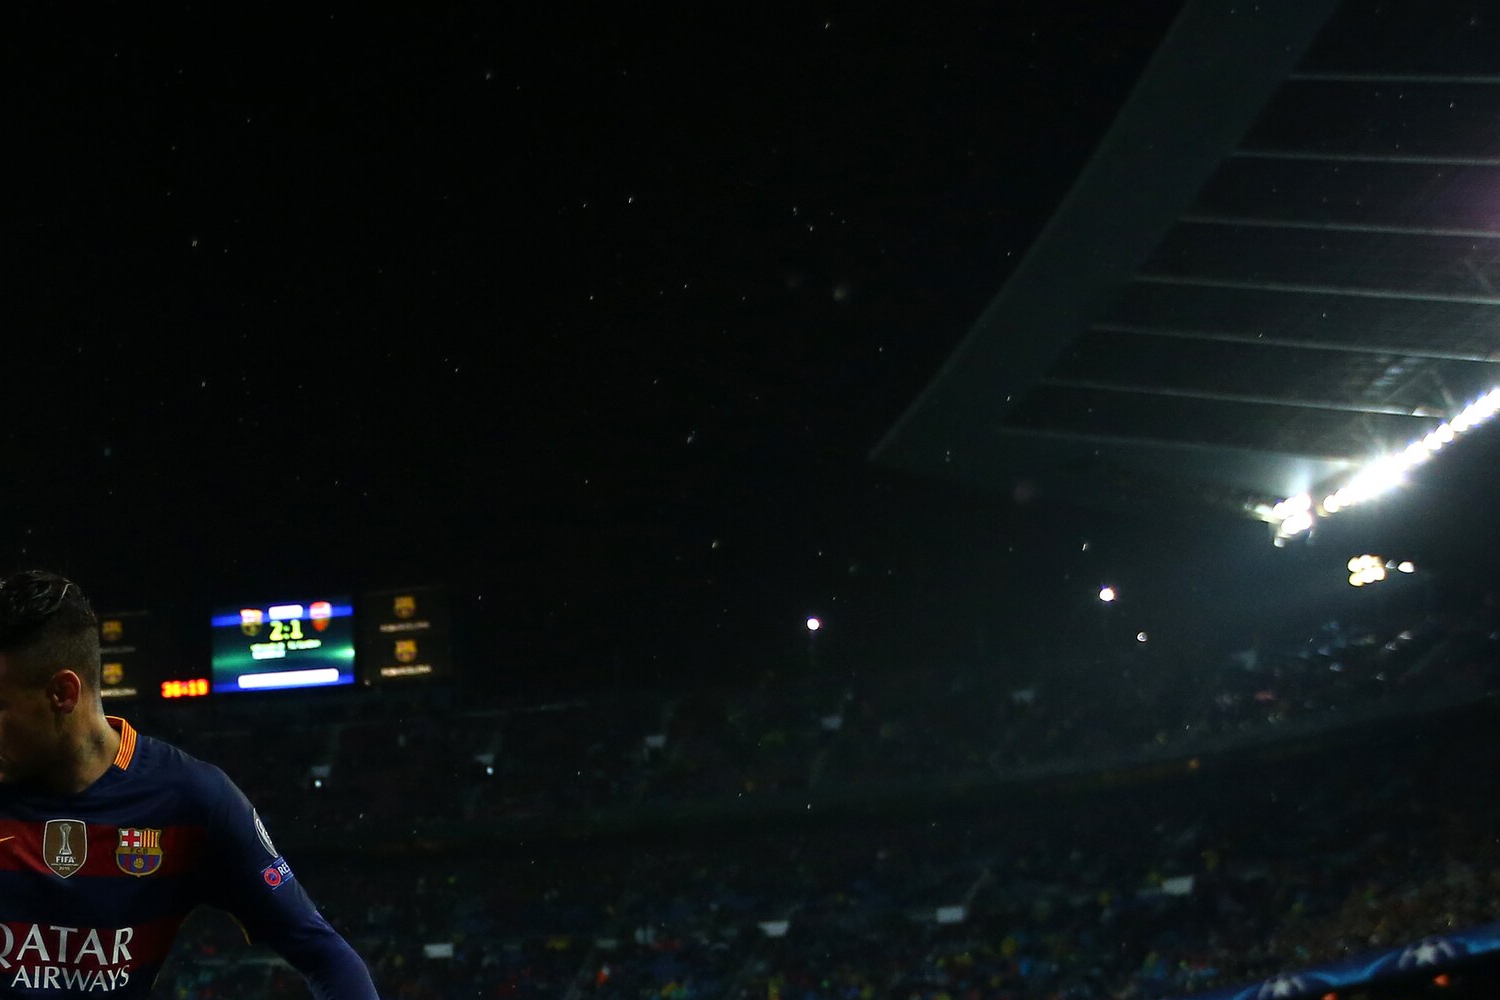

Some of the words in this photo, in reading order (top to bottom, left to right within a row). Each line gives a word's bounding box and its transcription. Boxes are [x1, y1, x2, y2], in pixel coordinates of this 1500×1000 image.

[269, 619, 303, 641] 2:1
[55, 855, 76, 864] FIFA
[10, 964, 131, 992] AIRWAYS
